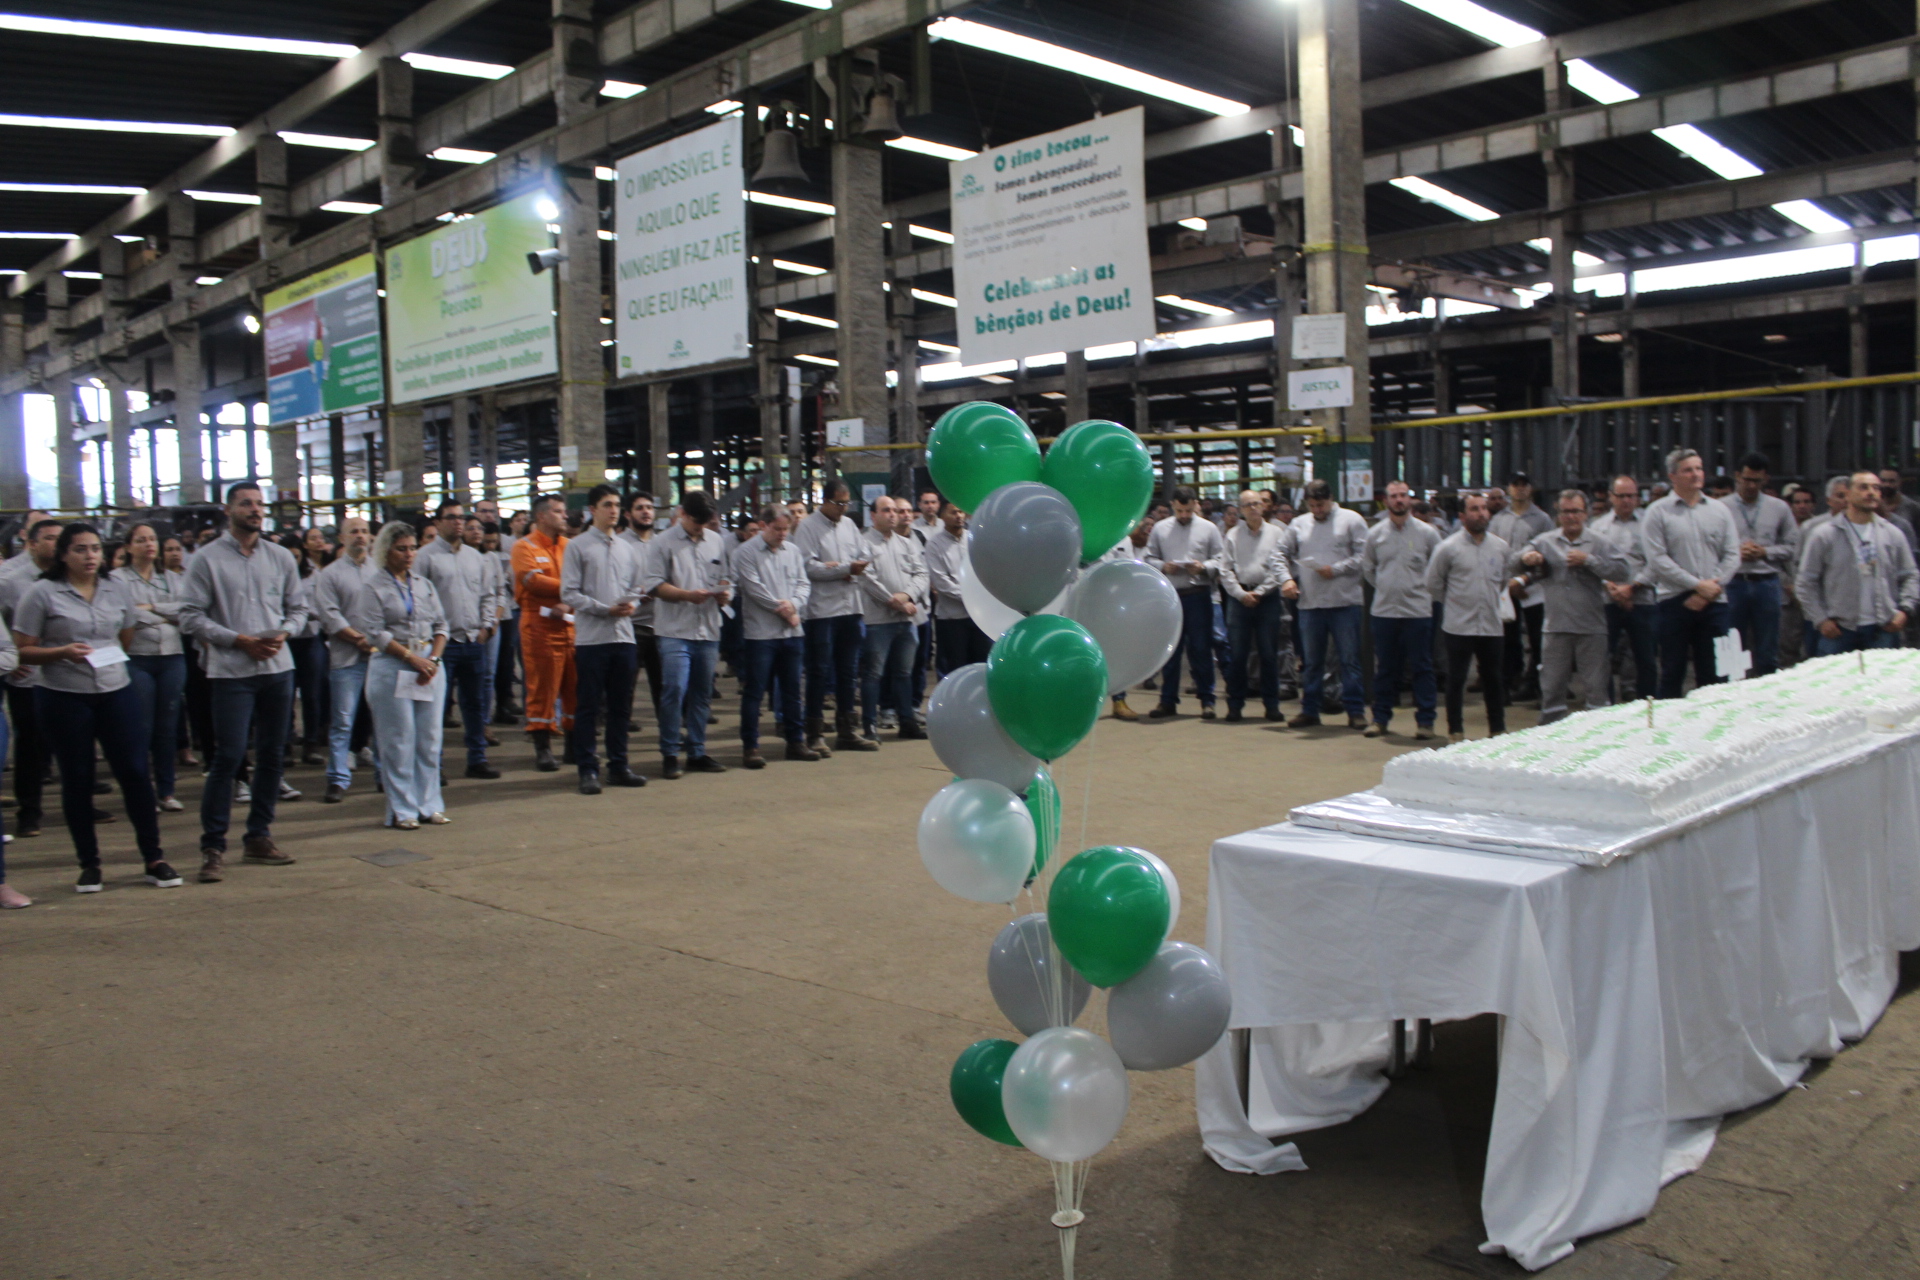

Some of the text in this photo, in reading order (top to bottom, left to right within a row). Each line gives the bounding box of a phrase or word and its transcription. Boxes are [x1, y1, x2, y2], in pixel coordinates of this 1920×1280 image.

[624, 140, 732, 199] O IMPOSSÍVEL É
[994, 154, 1006, 172] O
[1011, 149, 1042, 169] sino
[995, 178, 1026, 193] Somos
[1017, 188, 1048, 203] Somos
[636, 192, 721, 236] AQUILO QUE
[431, 221, 488, 278] DEUS
[619, 226, 742, 281] NINGUÉM FAZ ATÉ
[1095, 263, 1115, 280] as
[627, 278, 734, 320] QUE EU FAÇA!!!
[975, 287, 1131, 334] bênçãos de Deus!
[1301, 380, 1341, 392] JUSTIÇA
